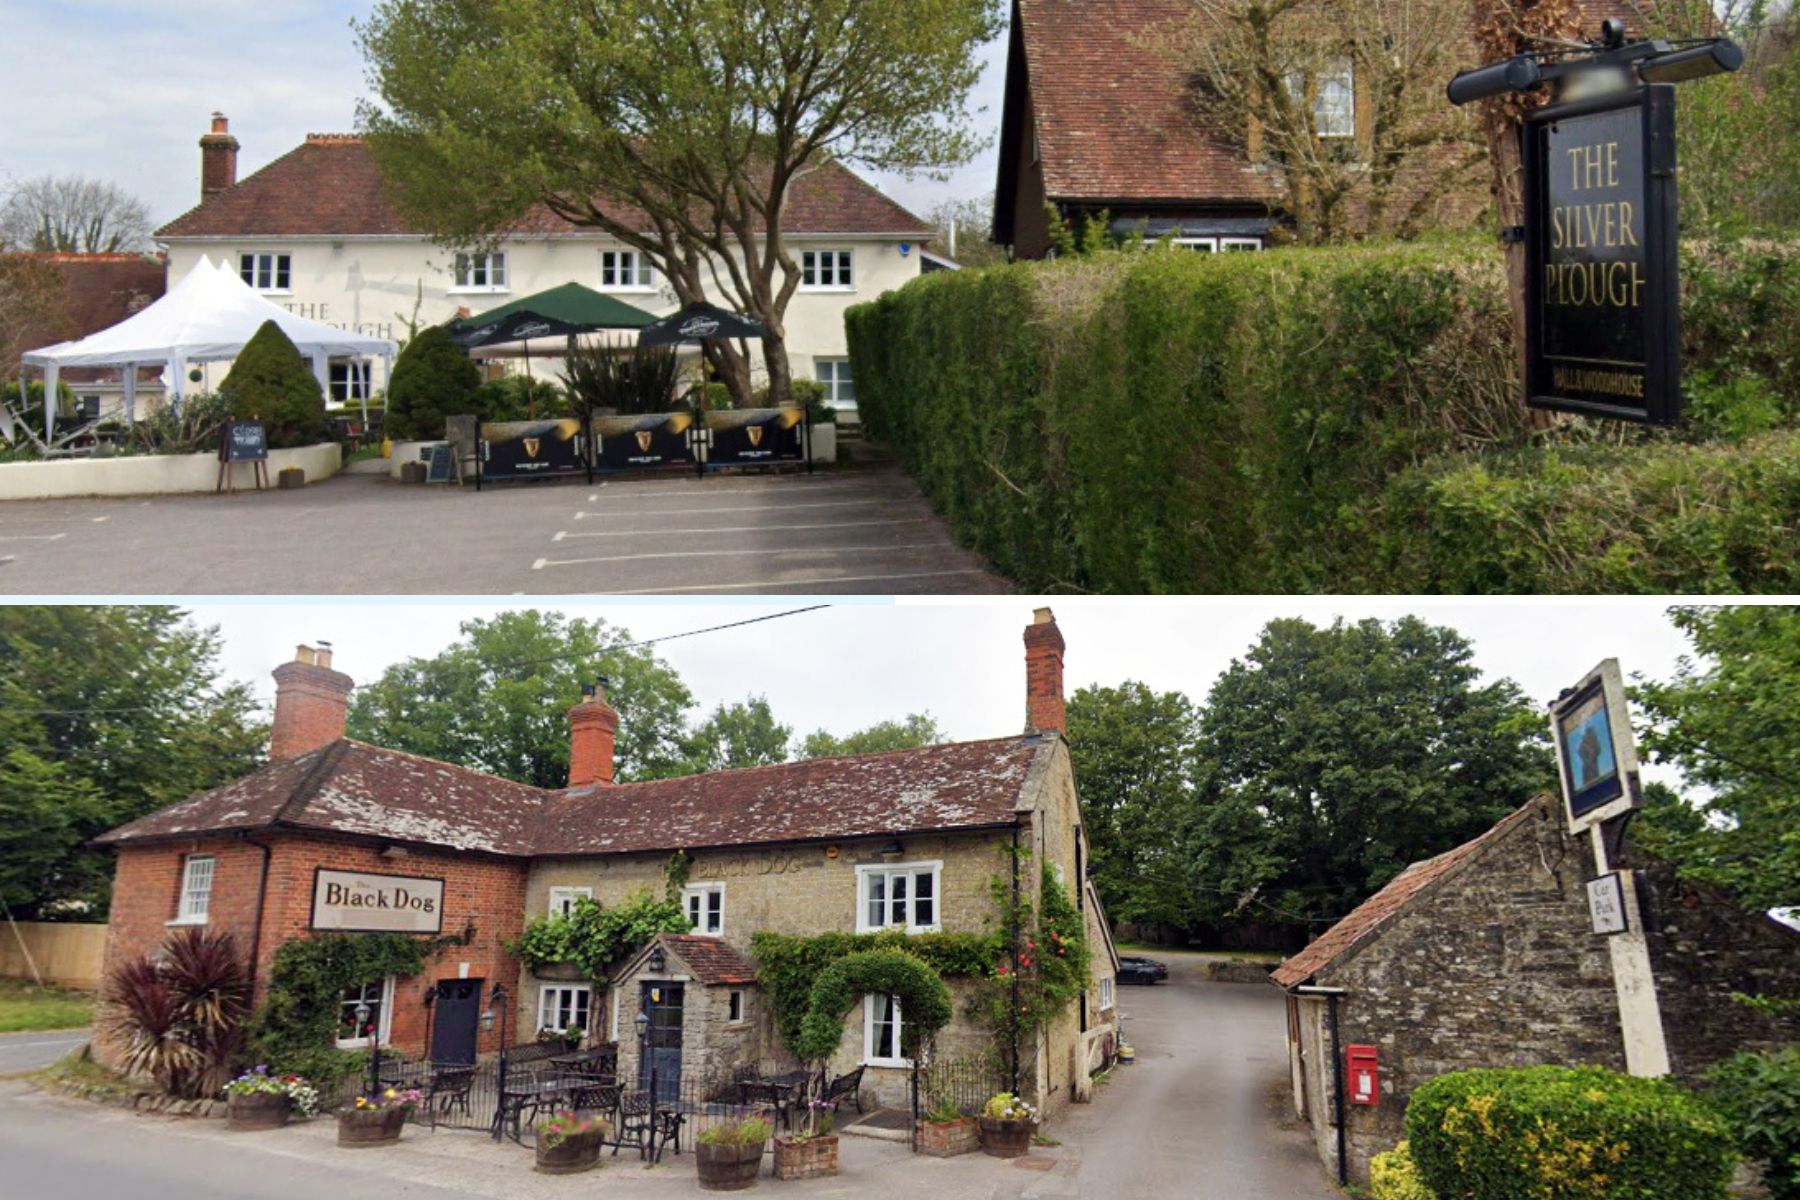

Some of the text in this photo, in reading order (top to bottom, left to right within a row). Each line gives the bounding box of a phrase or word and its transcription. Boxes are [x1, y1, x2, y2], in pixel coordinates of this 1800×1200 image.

[1567, 141, 1619, 191] THE
[1553, 201, 1638, 249] SILVER
[284, 303, 328, 319] THE
[699, 859, 750, 879] BLACK
[757, 853, 801, 876] DOG
[325, 882, 434, 912] Black Dog
